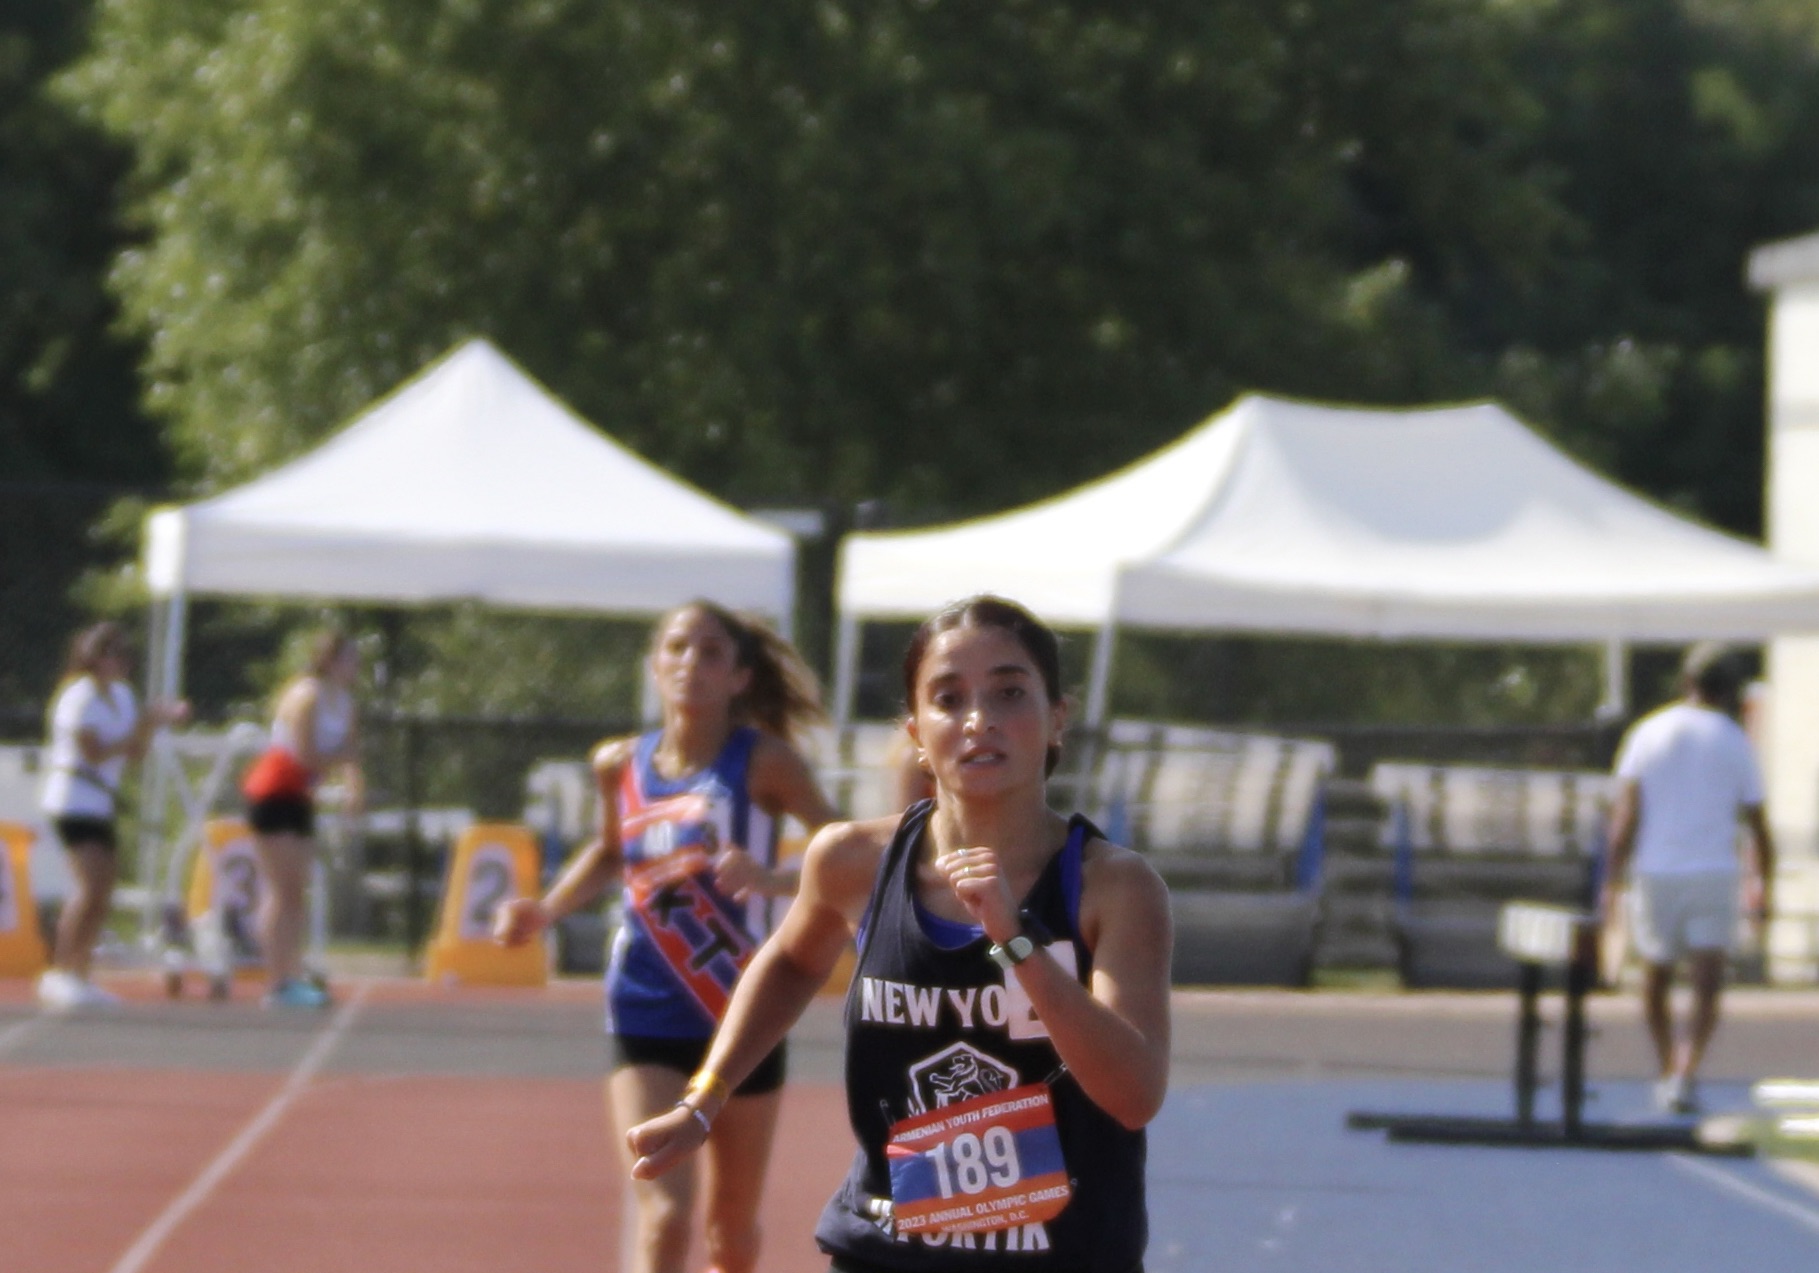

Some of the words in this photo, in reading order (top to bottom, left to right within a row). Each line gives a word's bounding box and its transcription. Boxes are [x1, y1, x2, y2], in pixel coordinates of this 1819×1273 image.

[471, 858, 509, 924] 2
[861, 976, 942, 1027] NEW
[947, 984, 1009, 1028] YO
[892, 1121, 946, 1143] ARMENIAN
[947, 1110, 981, 1129] YOUTH
[982, 1093, 1050, 1118] FEDERATION
[924, 1125, 1021, 1200] 189
[898, 1214, 926, 1230] 2023
[929, 1206, 974, 1225] ANNUAL
[975, 1194, 1027, 1215] OLYMPIC
[1029, 1185, 1070, 1203] GAMES
[1009, 1209, 1031, 1221] D.C.
